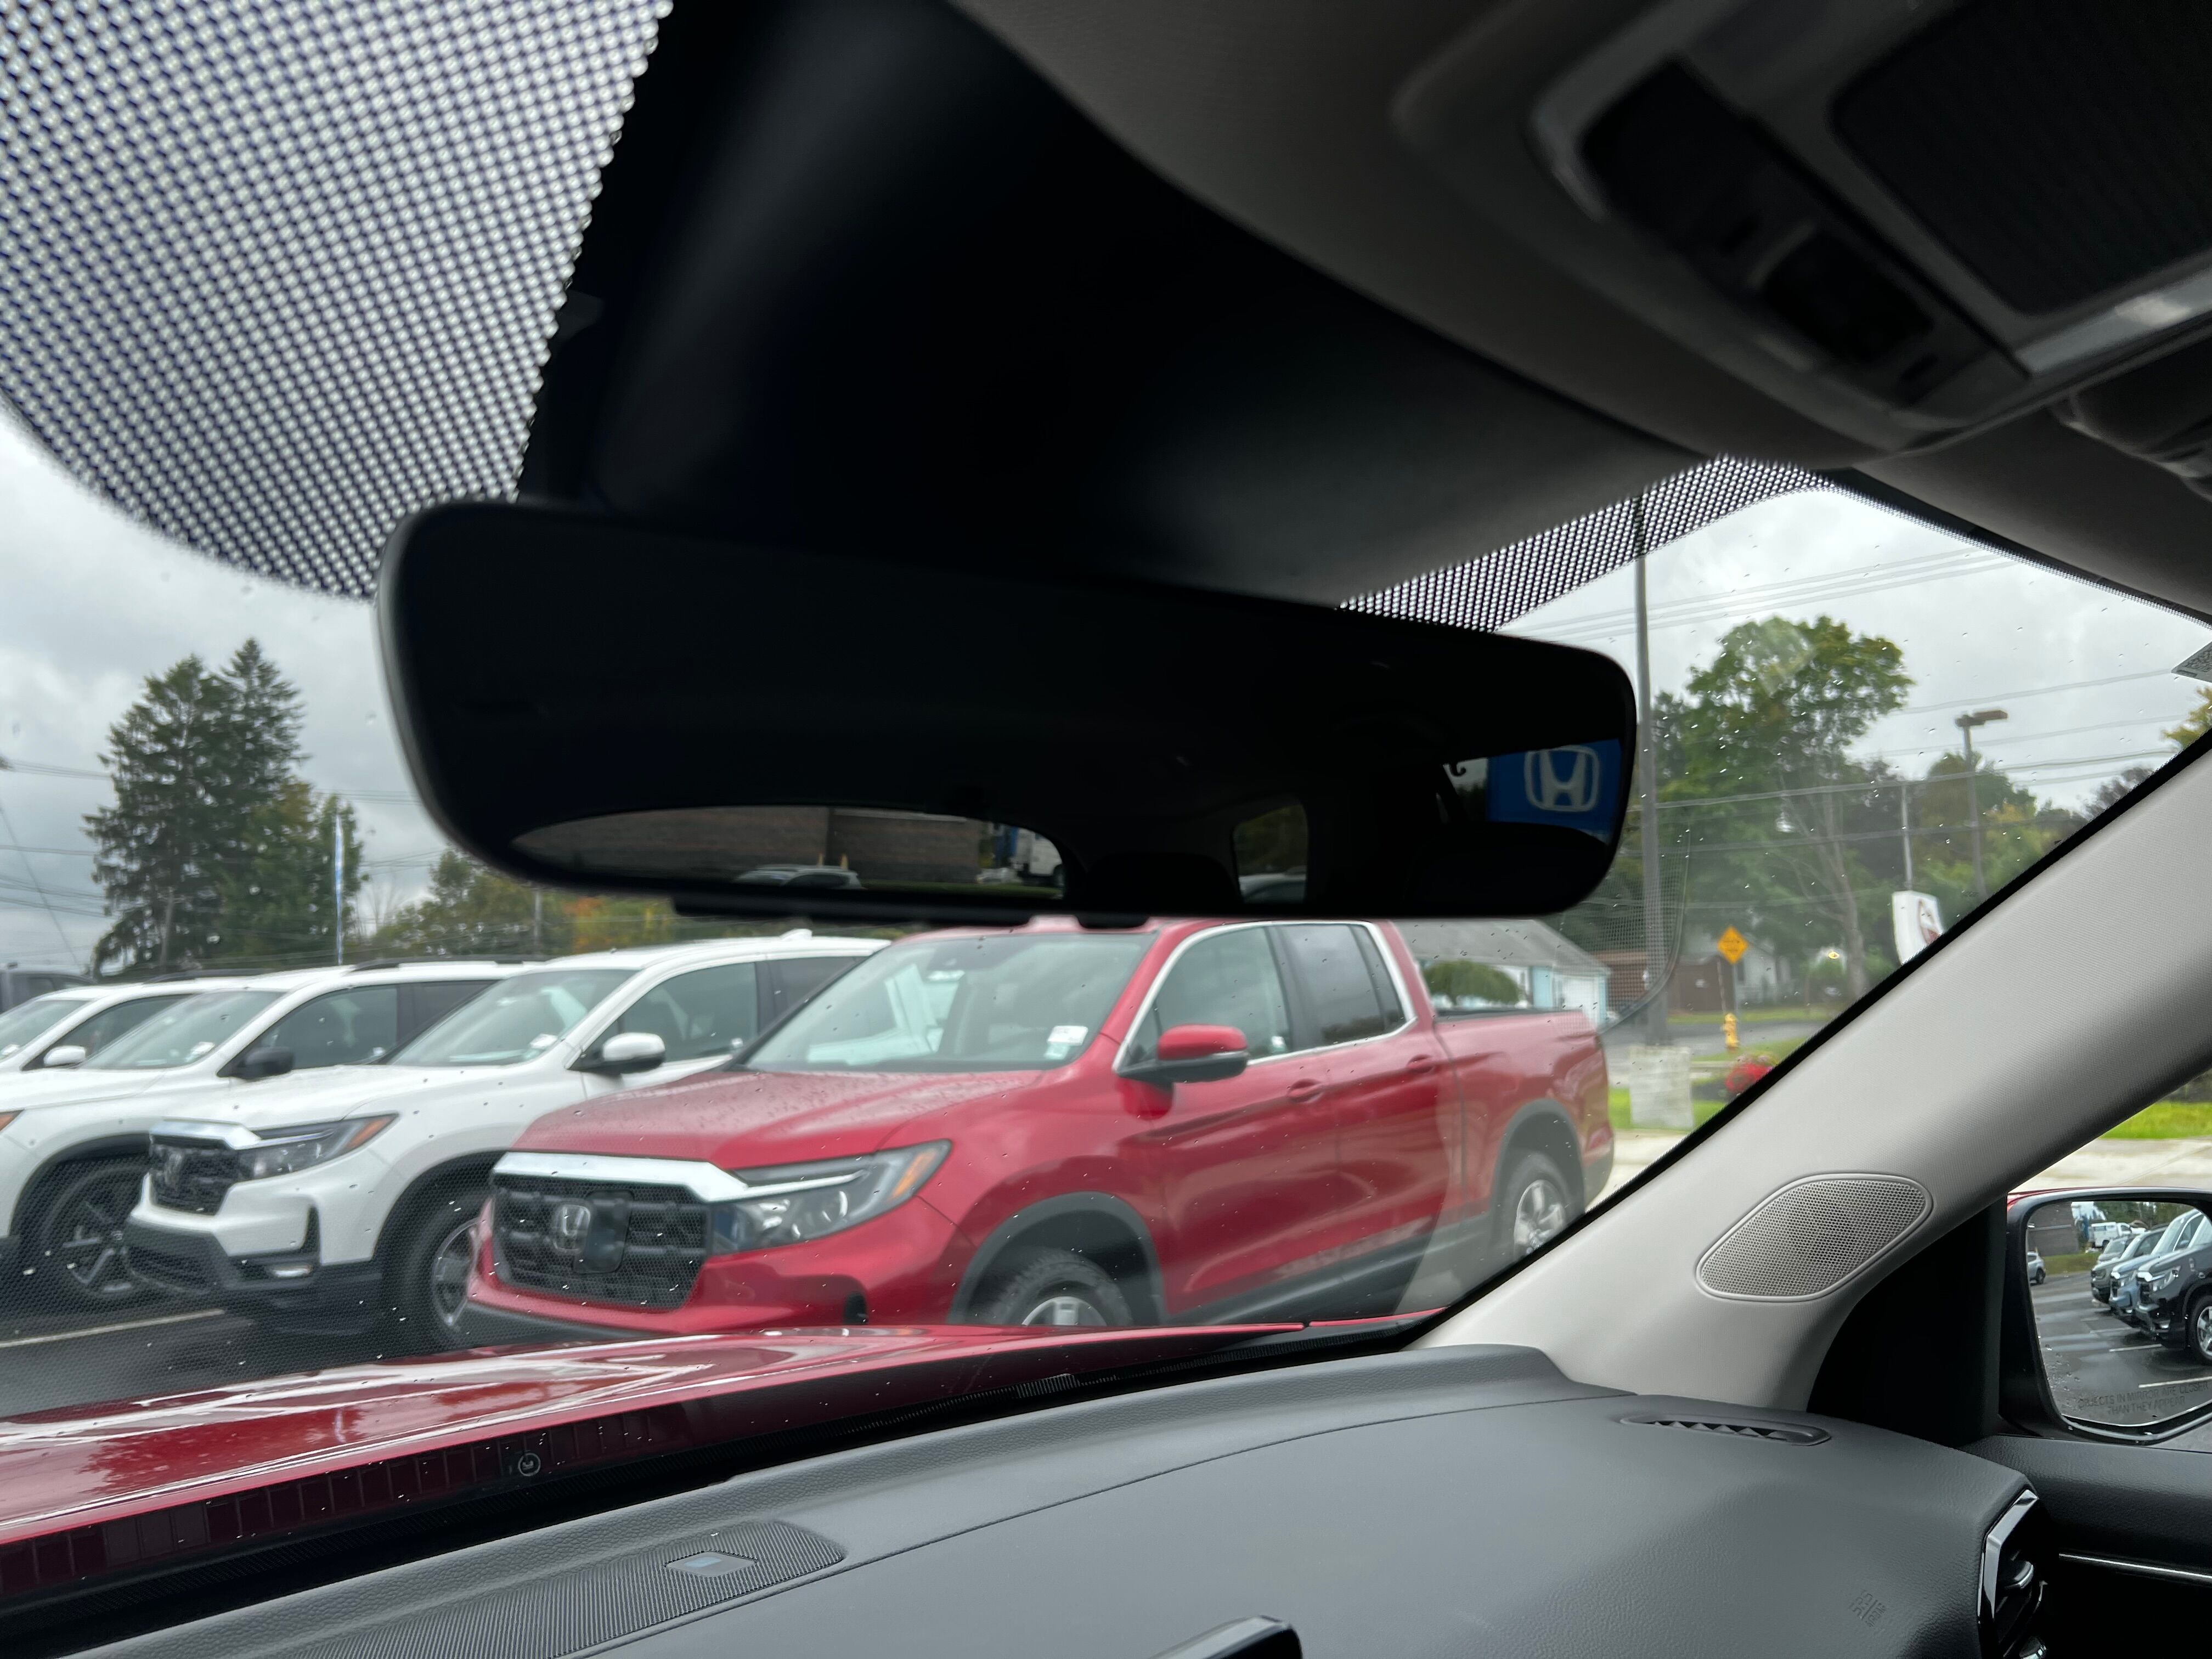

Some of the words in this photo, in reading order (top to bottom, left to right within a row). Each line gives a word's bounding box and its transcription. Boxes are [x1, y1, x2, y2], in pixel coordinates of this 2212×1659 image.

[2078, 1395, 2114, 1408] OBJECTS
[2116, 1393, 2126, 1402] IN
[2127, 1389, 2160, 1401] MIRROR
[2162, 1386, 2176, 1396] ARE
[2180, 1380, 2209, 1394] CLOSER
[2107, 1404, 2130, 1415] THAN
[2130, 1401, 2153, 1412] THEY
[2154, 1396, 2186, 1410] APPEAR
[1849, 1589, 1874, 1616] SRS
